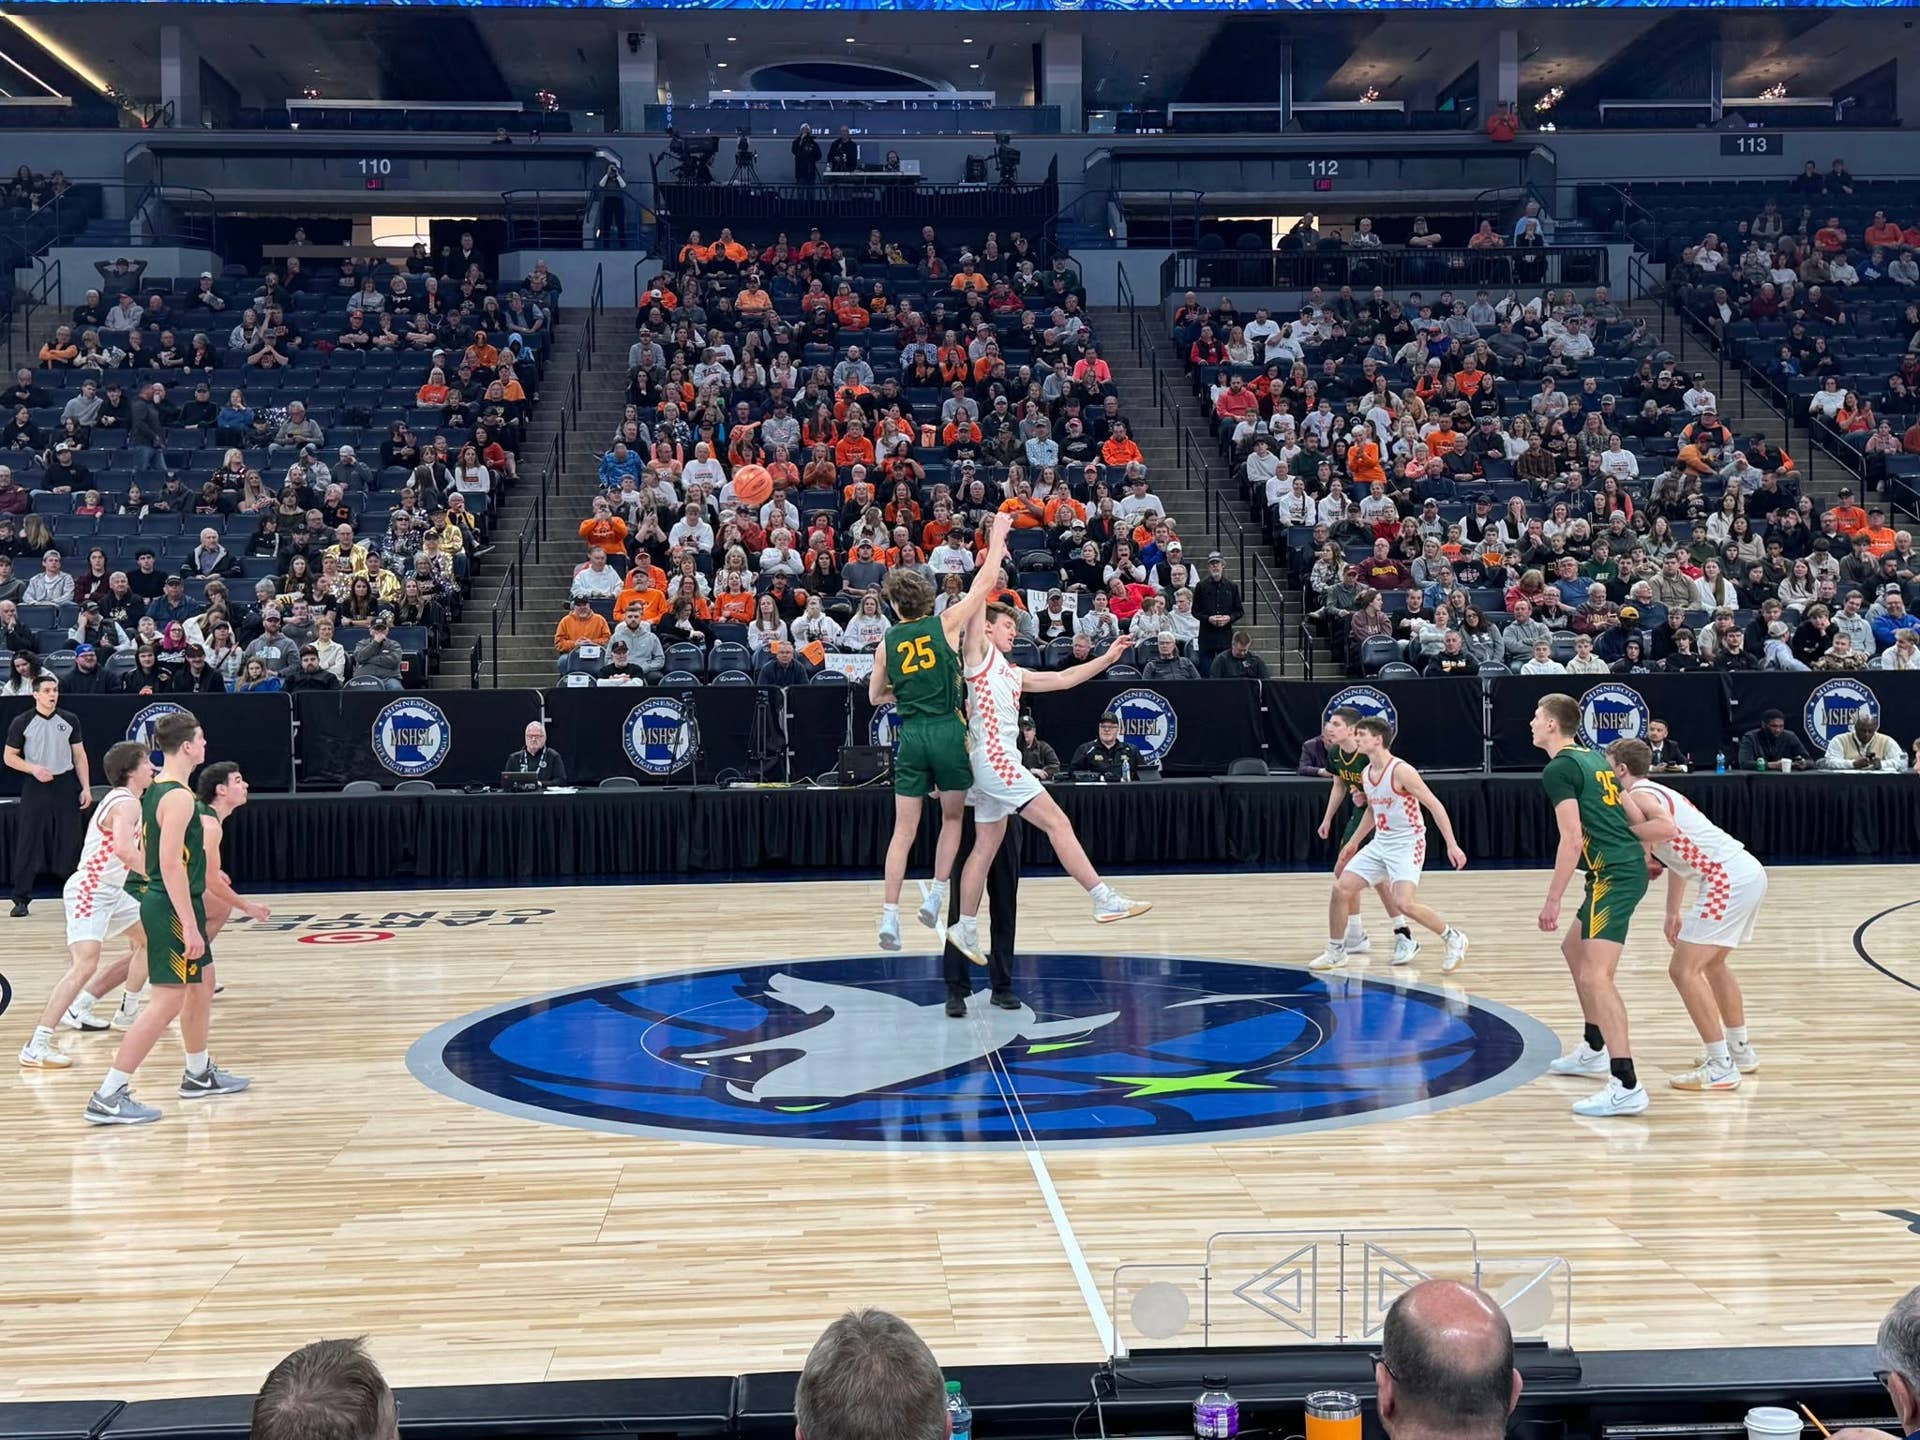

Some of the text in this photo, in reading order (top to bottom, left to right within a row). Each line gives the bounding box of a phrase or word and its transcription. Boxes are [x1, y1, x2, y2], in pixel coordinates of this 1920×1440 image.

[1737, 137, 1767, 152] 113
[359, 159, 391, 174] 110
[1308, 160, 1339, 175] 112
[897, 635, 937, 675] 25
[1333, 688, 1386, 706] MINNESOTA
[1585, 685, 1638, 702] MINNESOTA
[1816, 681, 1869, 698] MINNESOTA
[1113, 691, 1166, 708] MINNESOTA
[384, 700, 438, 718] MINNESOTA
[1119, 718, 1161, 736] MSHSL
[1591, 712, 1634, 730] MSHSL
[390, 728, 434, 746] MSHSL
[1595, 770, 1622, 806] 35
